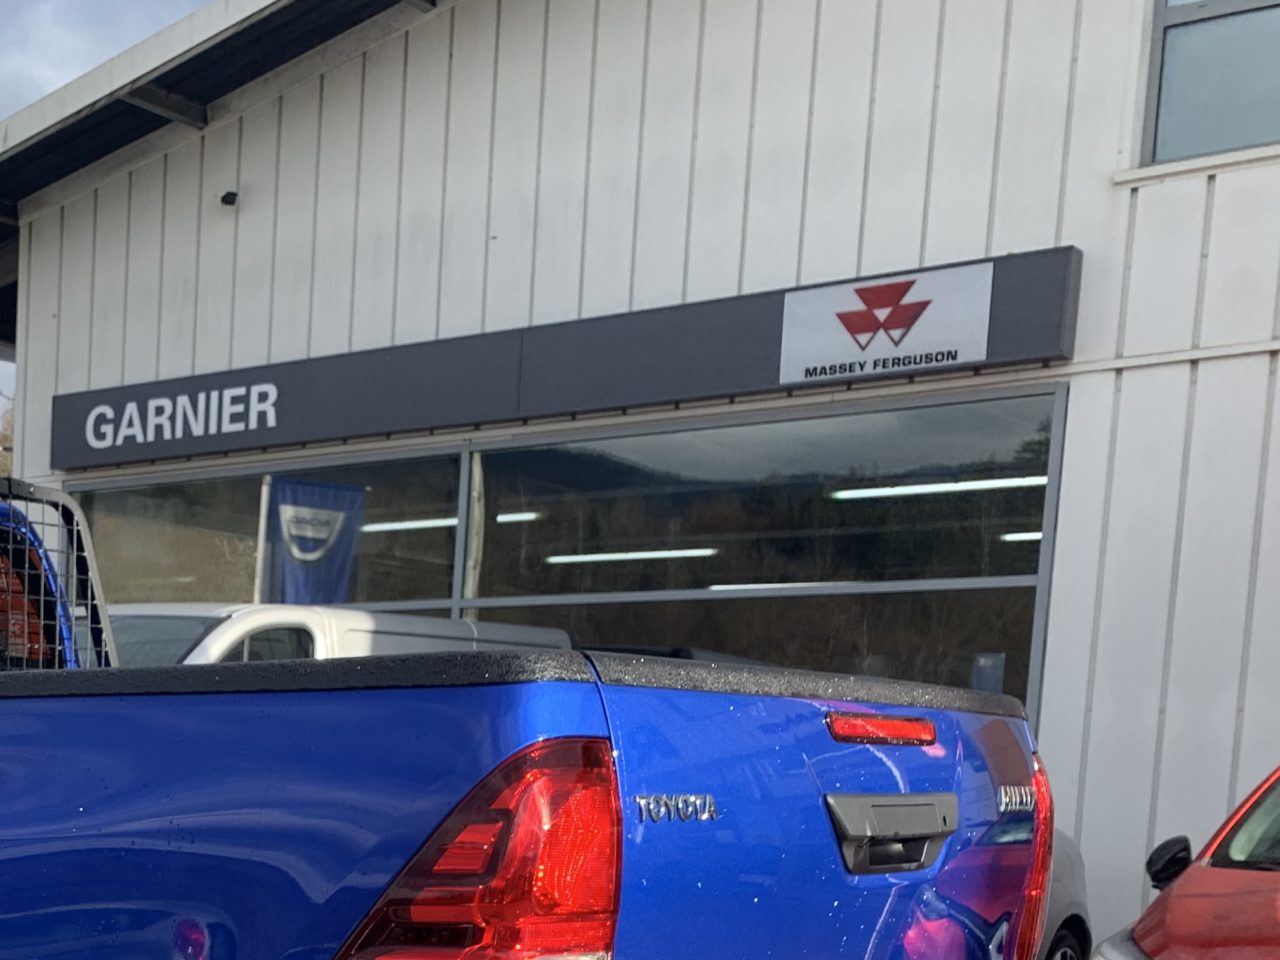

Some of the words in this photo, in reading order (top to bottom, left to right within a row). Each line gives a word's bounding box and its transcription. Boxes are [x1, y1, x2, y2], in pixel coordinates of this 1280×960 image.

[804, 360, 867, 379] MASSEY
[873, 350, 959, 370] FERGUSON
[85, 383, 278, 449] GARNIER
[633, 794, 718, 823] TOYOTA
